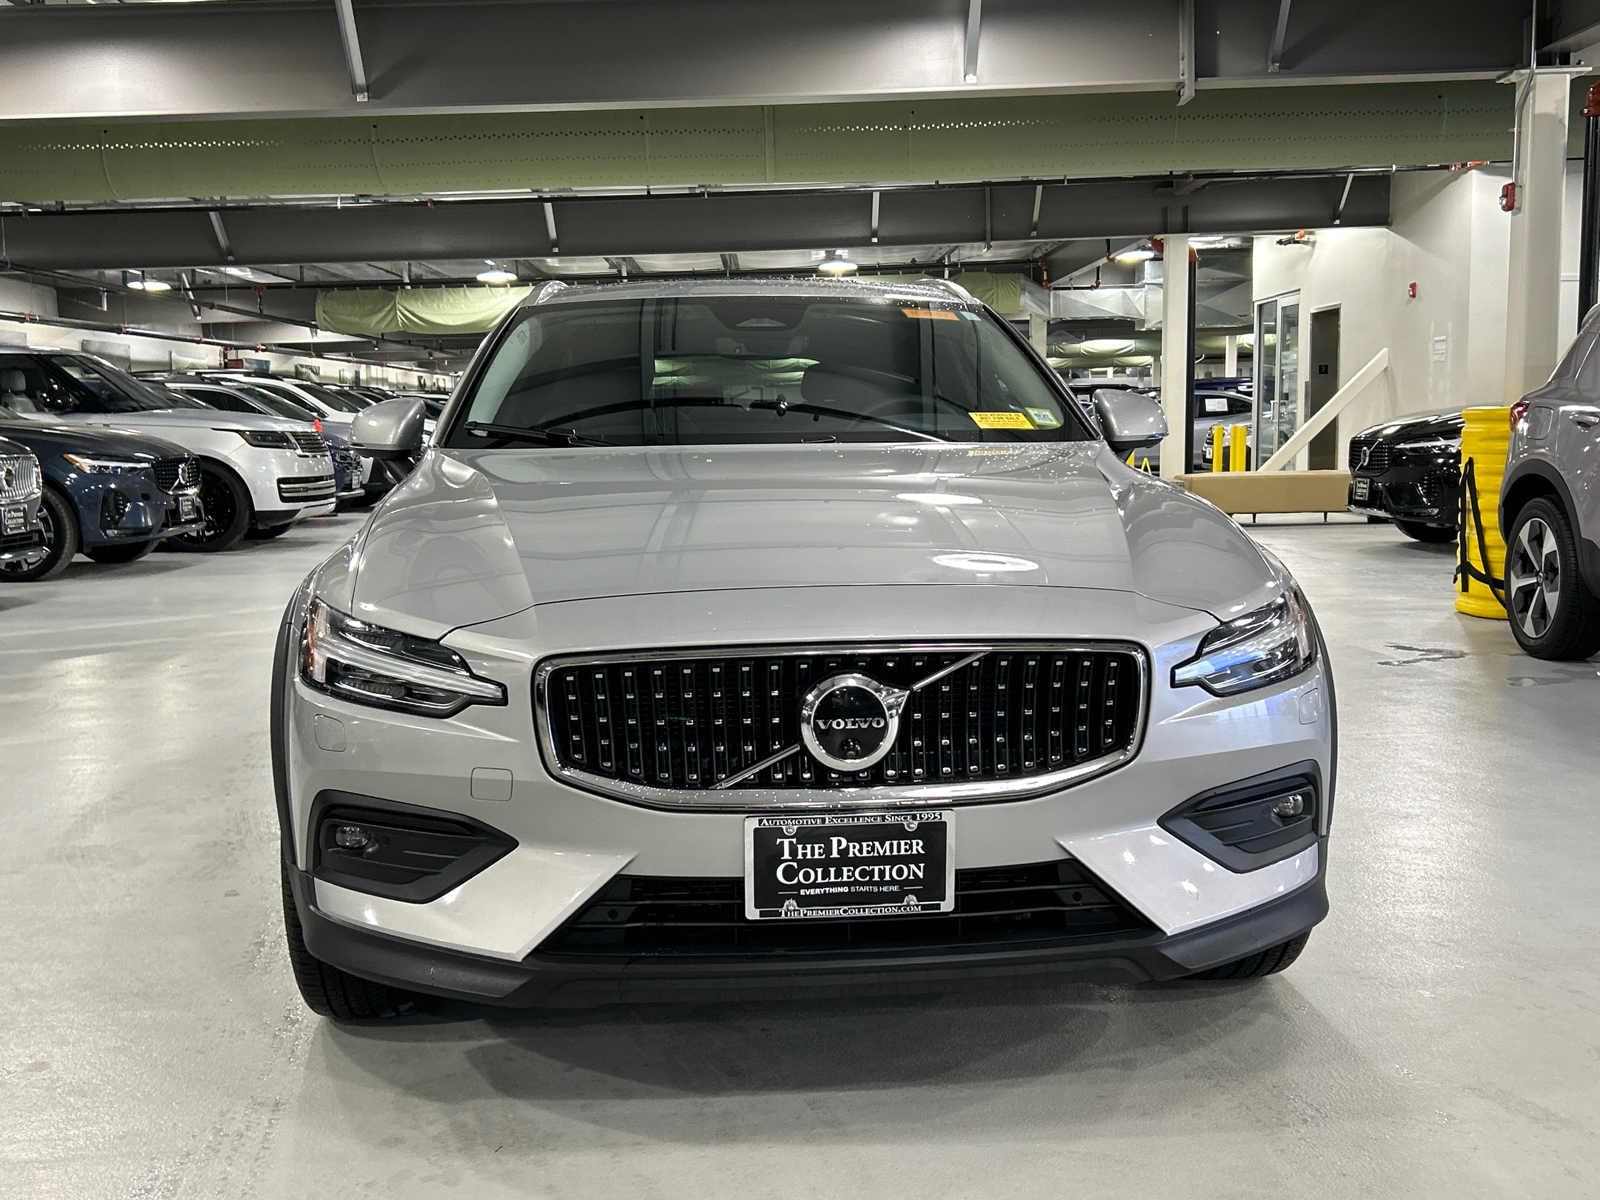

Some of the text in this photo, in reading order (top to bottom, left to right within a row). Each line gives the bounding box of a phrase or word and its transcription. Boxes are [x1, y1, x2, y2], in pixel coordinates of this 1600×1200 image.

[816, 717, 885, 730] VOLVO
[760, 812, 941, 826] AUTOMOTIVE EXCELLENCE SINCE 1995
[776, 836, 925, 860] THE PREMIER
[776, 861, 926, 885] COLLECTION
[800, 886, 849, 896] EVERYTHING
[850, 885, 879, 893] STARTS
